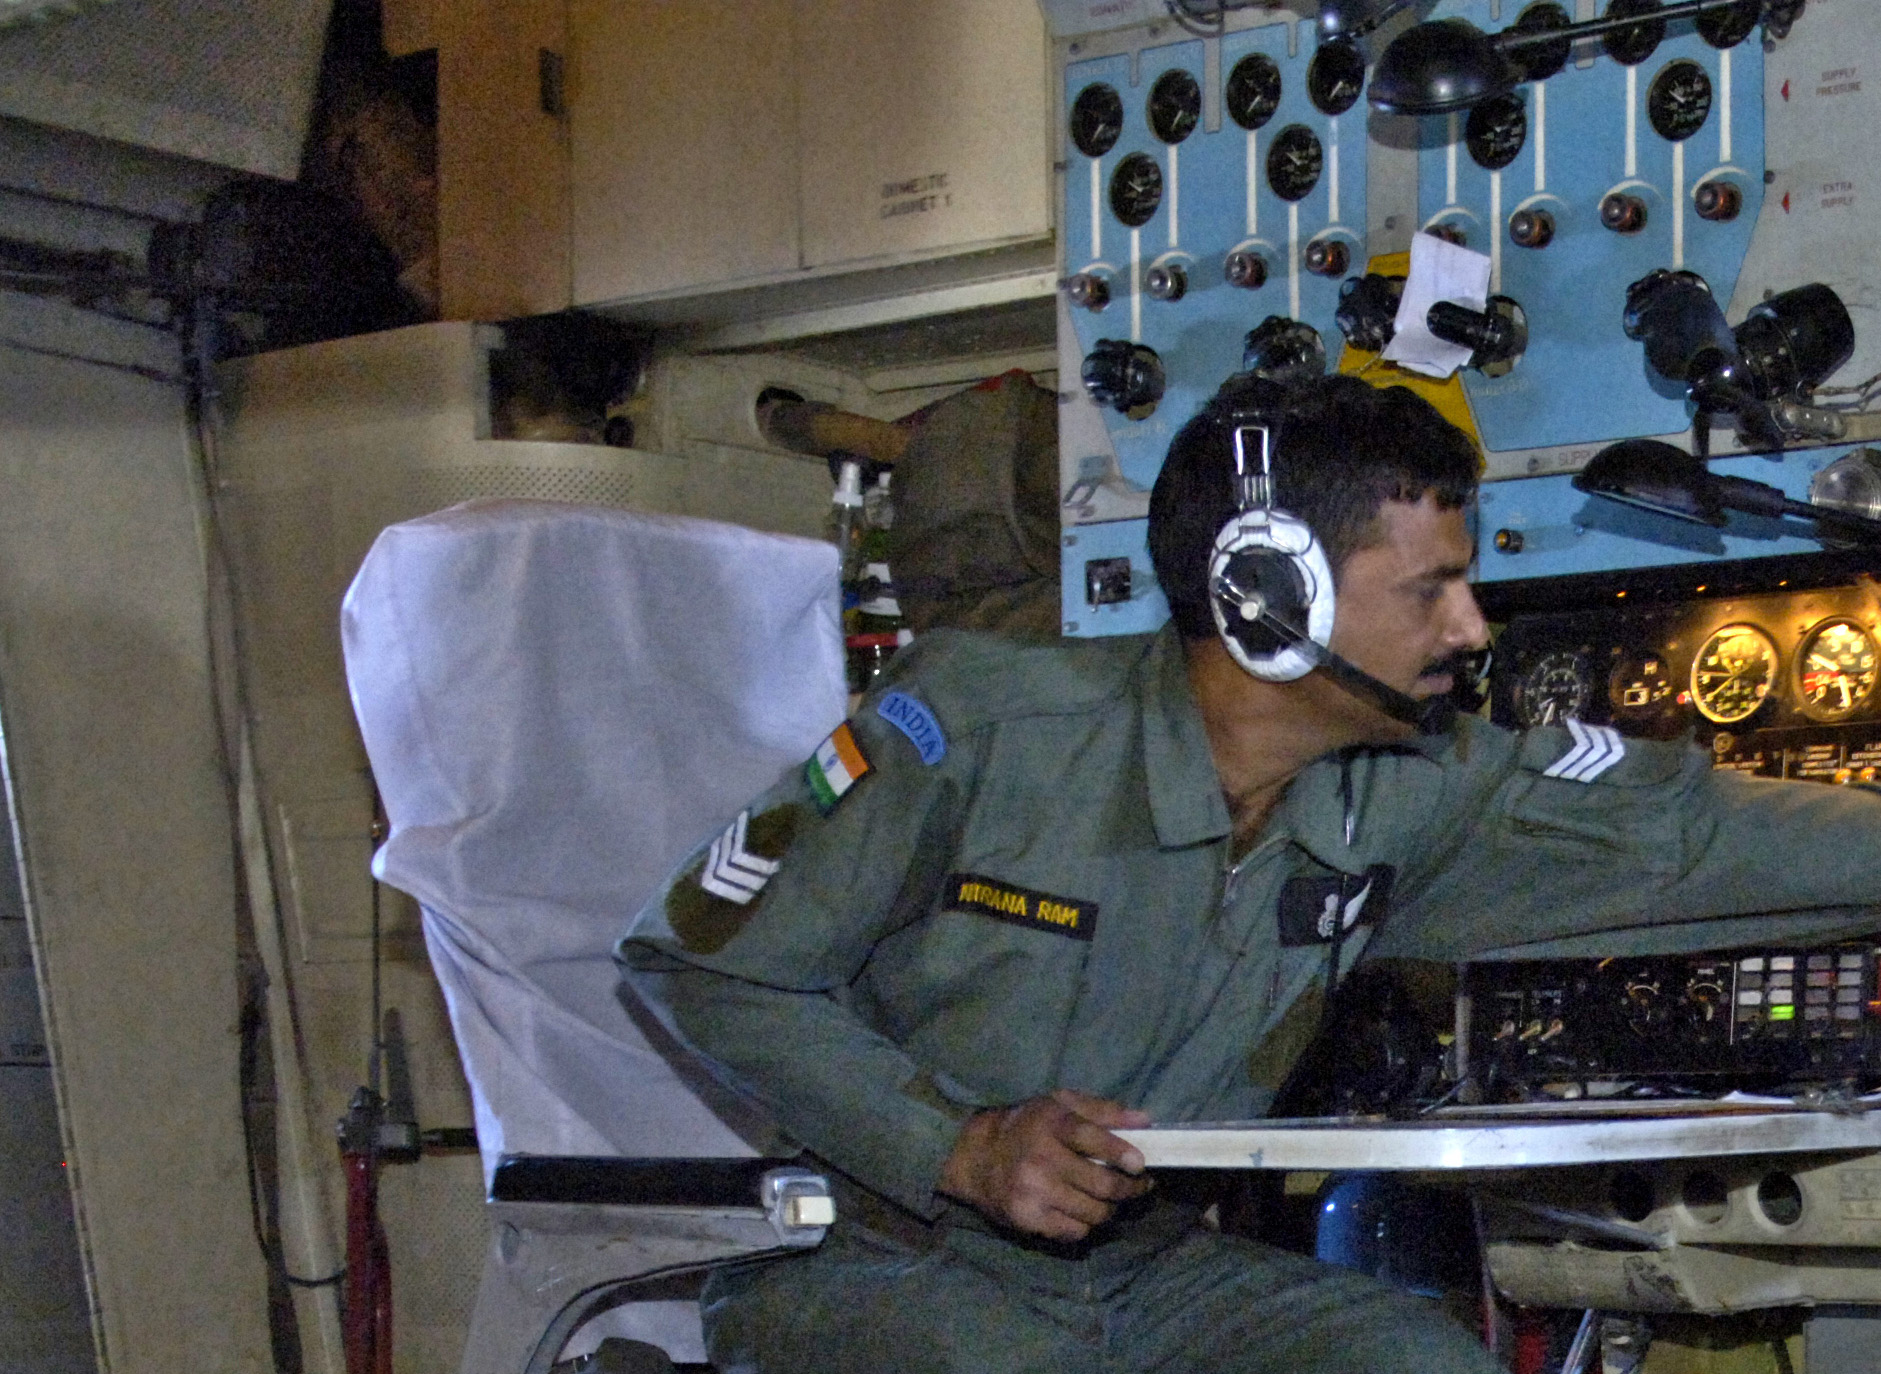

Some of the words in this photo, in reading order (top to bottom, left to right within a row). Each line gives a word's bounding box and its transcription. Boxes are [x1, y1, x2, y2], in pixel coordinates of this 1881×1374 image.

[1815, 81, 1861, 96] PRESSURE
[1823, 181, 1852, 195] EXTRA
[886, 696, 937, 760] INDIA
[1036, 900, 1080, 928] RAM
